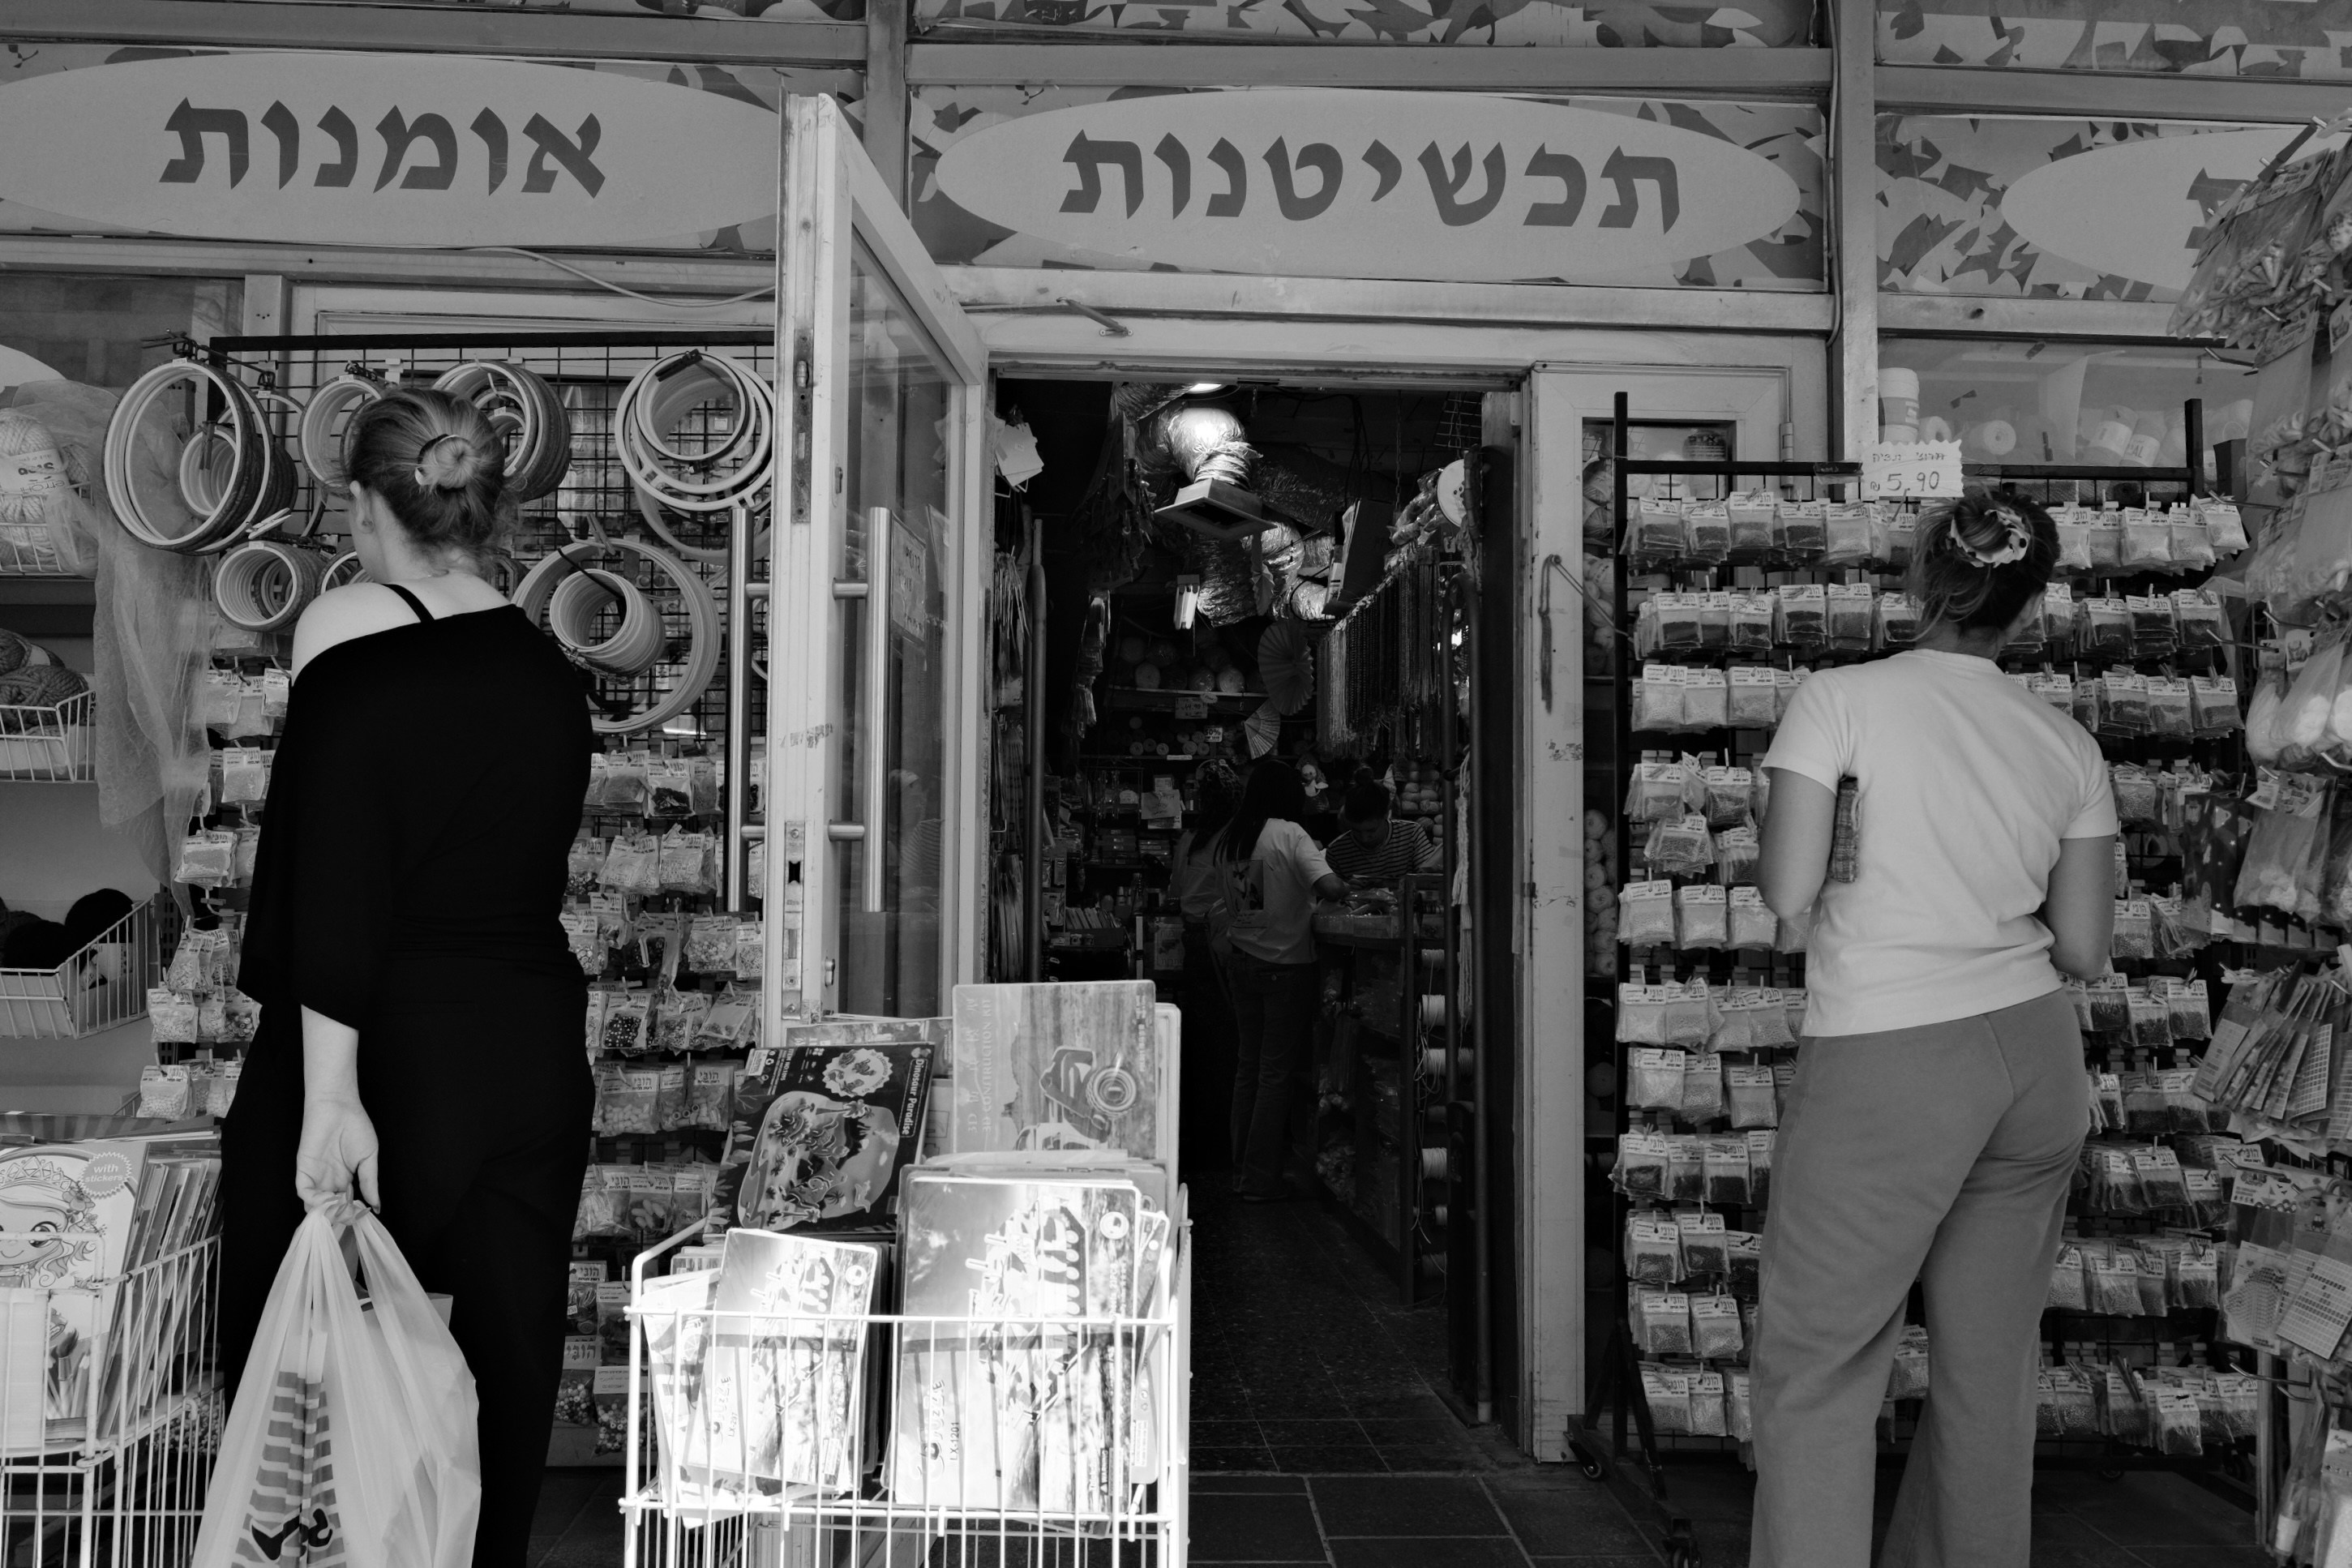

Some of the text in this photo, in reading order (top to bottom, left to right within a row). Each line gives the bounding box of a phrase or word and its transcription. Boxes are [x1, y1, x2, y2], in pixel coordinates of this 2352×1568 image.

[159, 96, 606, 199] אומנות
[1059, 128, 1680, 234] תכשיטנות
[983, 1022, 992, 1112] CONSTRUCTION
[633, 1077, 652, 1086] הובי
[700, 1072, 719, 1081] הובי
[902, 1059, 924, 1135] Dinosaur Paradise
[93, 1164, 118, 1173] with
[85, 1175, 123, 1183] stickers
[580, 1269, 599, 1277] הובי
[567, 1344, 596, 1360] הובי
[950, 1422, 960, 1460] LX-1201
